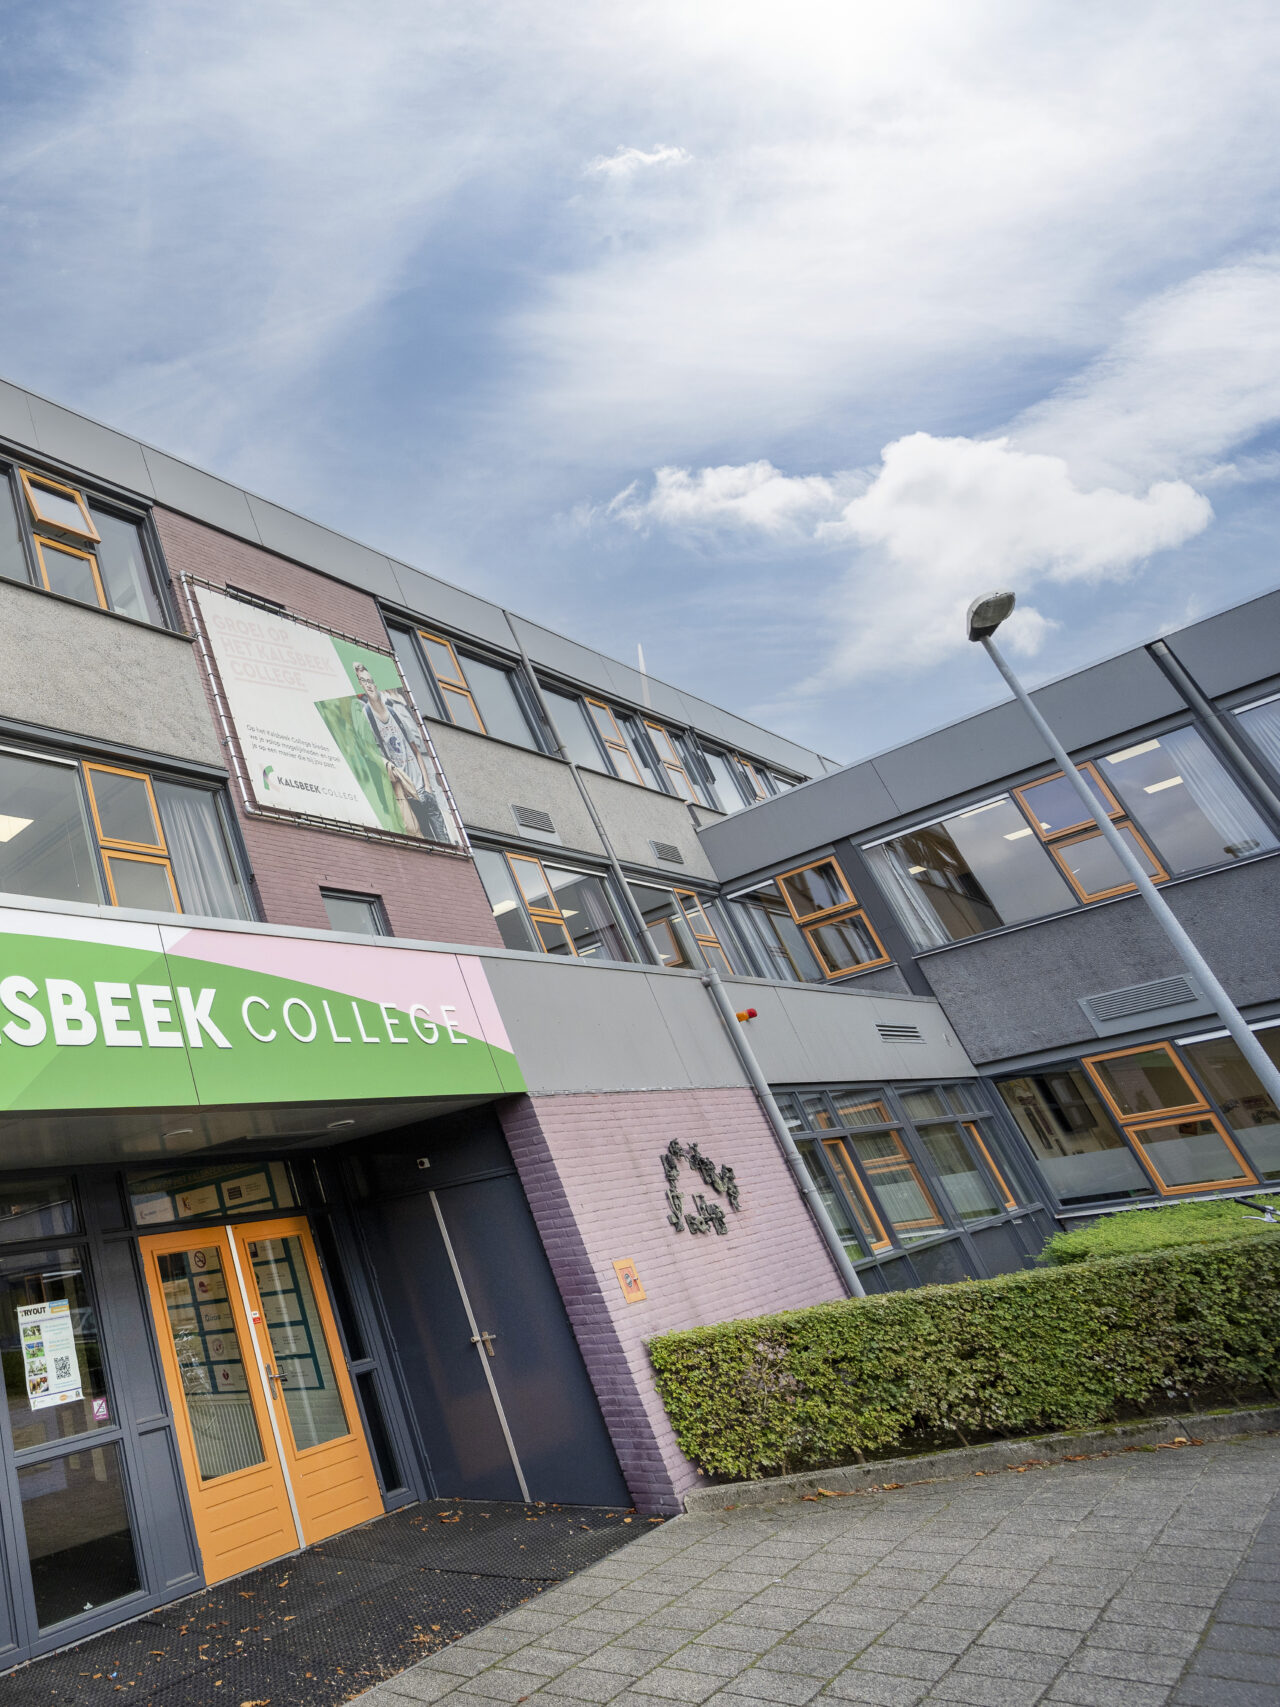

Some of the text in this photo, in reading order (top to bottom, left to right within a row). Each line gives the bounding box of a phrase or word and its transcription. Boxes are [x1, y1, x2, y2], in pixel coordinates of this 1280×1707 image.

[212, 614, 289, 642] GROEI OP
[221, 636, 334, 673] HET KALSBEEK
[230, 661, 305, 688] COLLEGE
[277, 776, 321, 794] KALSBEEK
[241, 995, 469, 1045] COLLEGE
